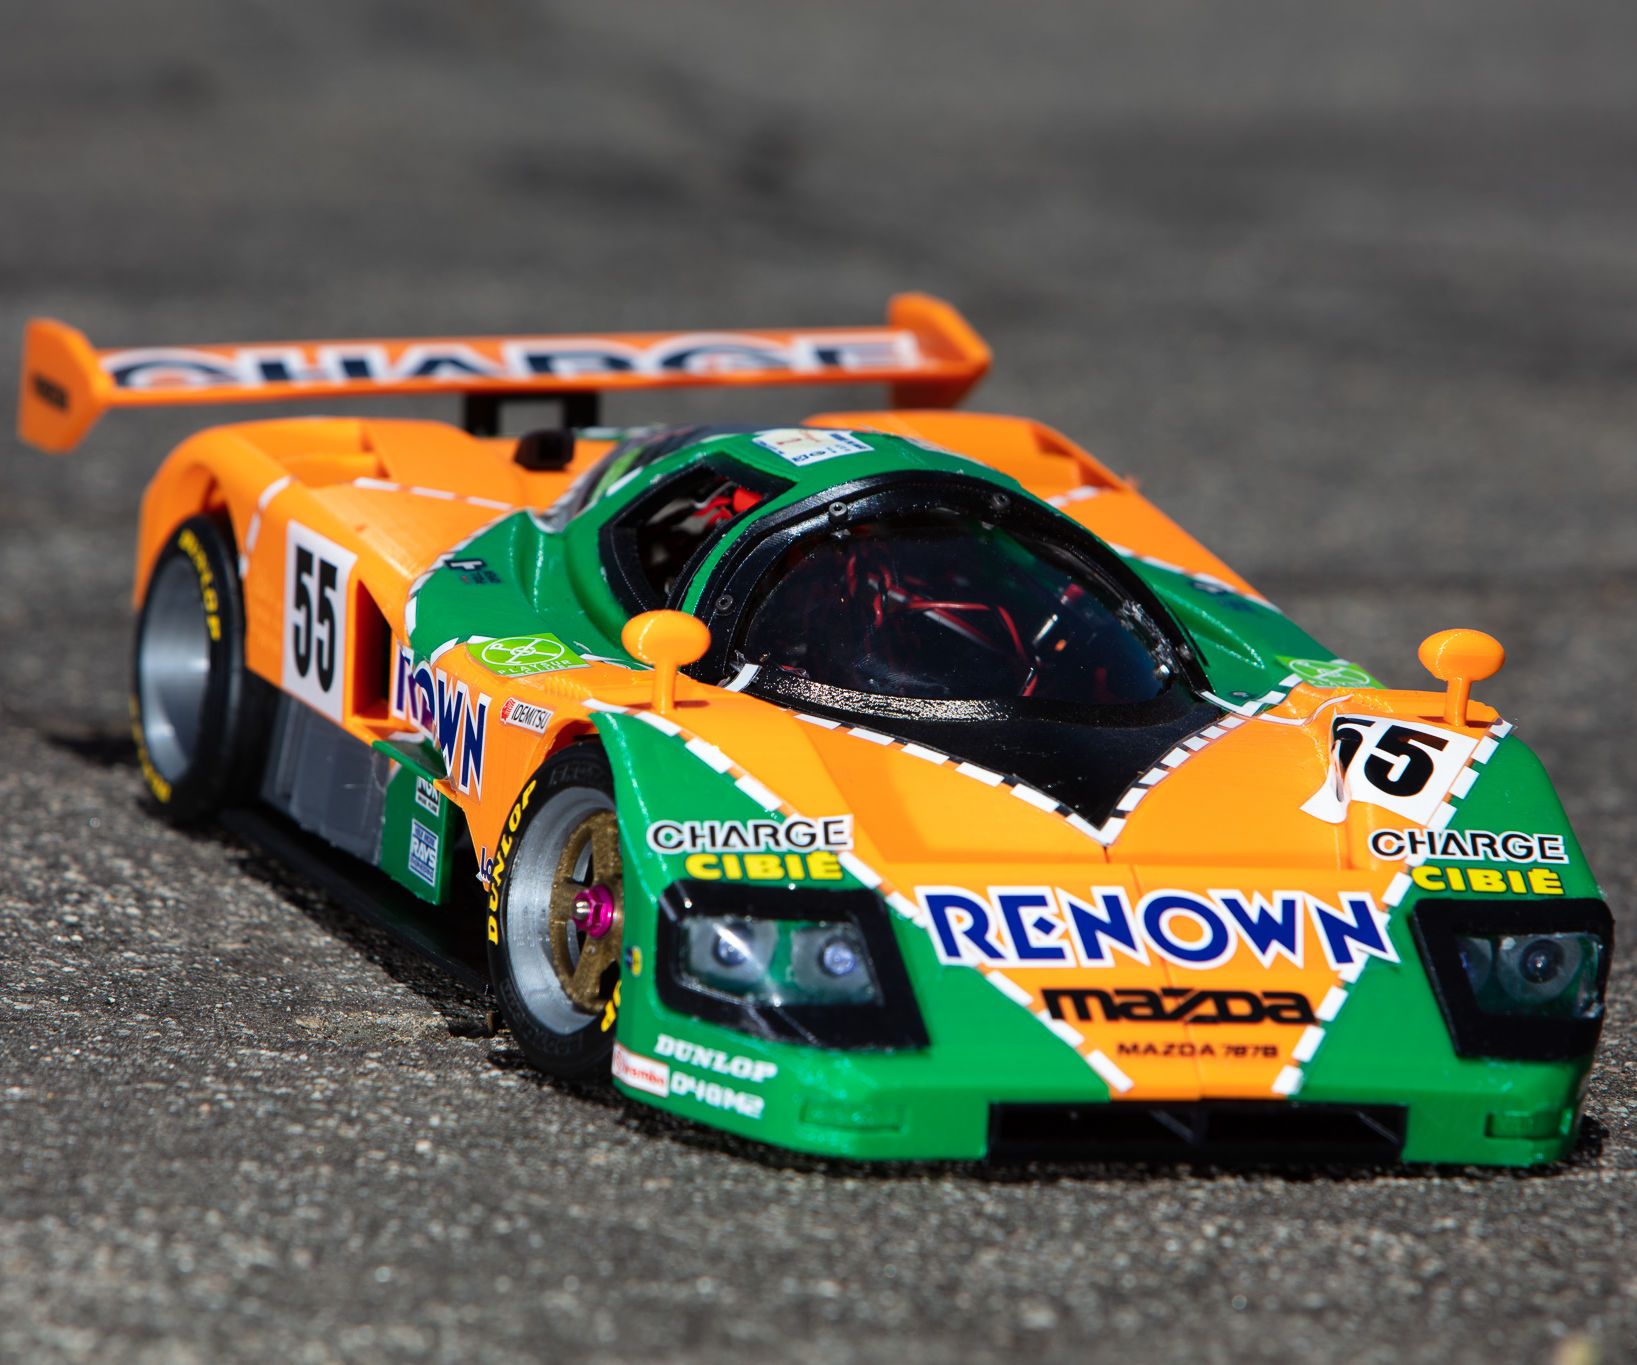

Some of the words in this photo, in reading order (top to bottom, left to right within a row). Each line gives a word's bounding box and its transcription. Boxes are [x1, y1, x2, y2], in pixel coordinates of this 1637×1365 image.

[293, 544, 337, 693] 55
[511, 702, 552, 731] IDEMITSU
[649, 816, 852, 853] CHARGE
[1369, 829, 1568, 863] CHARGE
[487, 779, 537, 945] DUNLOP
[916, 888, 1398, 969] RENOWN
[654, 1033, 779, 1083] DUNLOP
[1117, 1042, 1215, 1058] MAZDA
